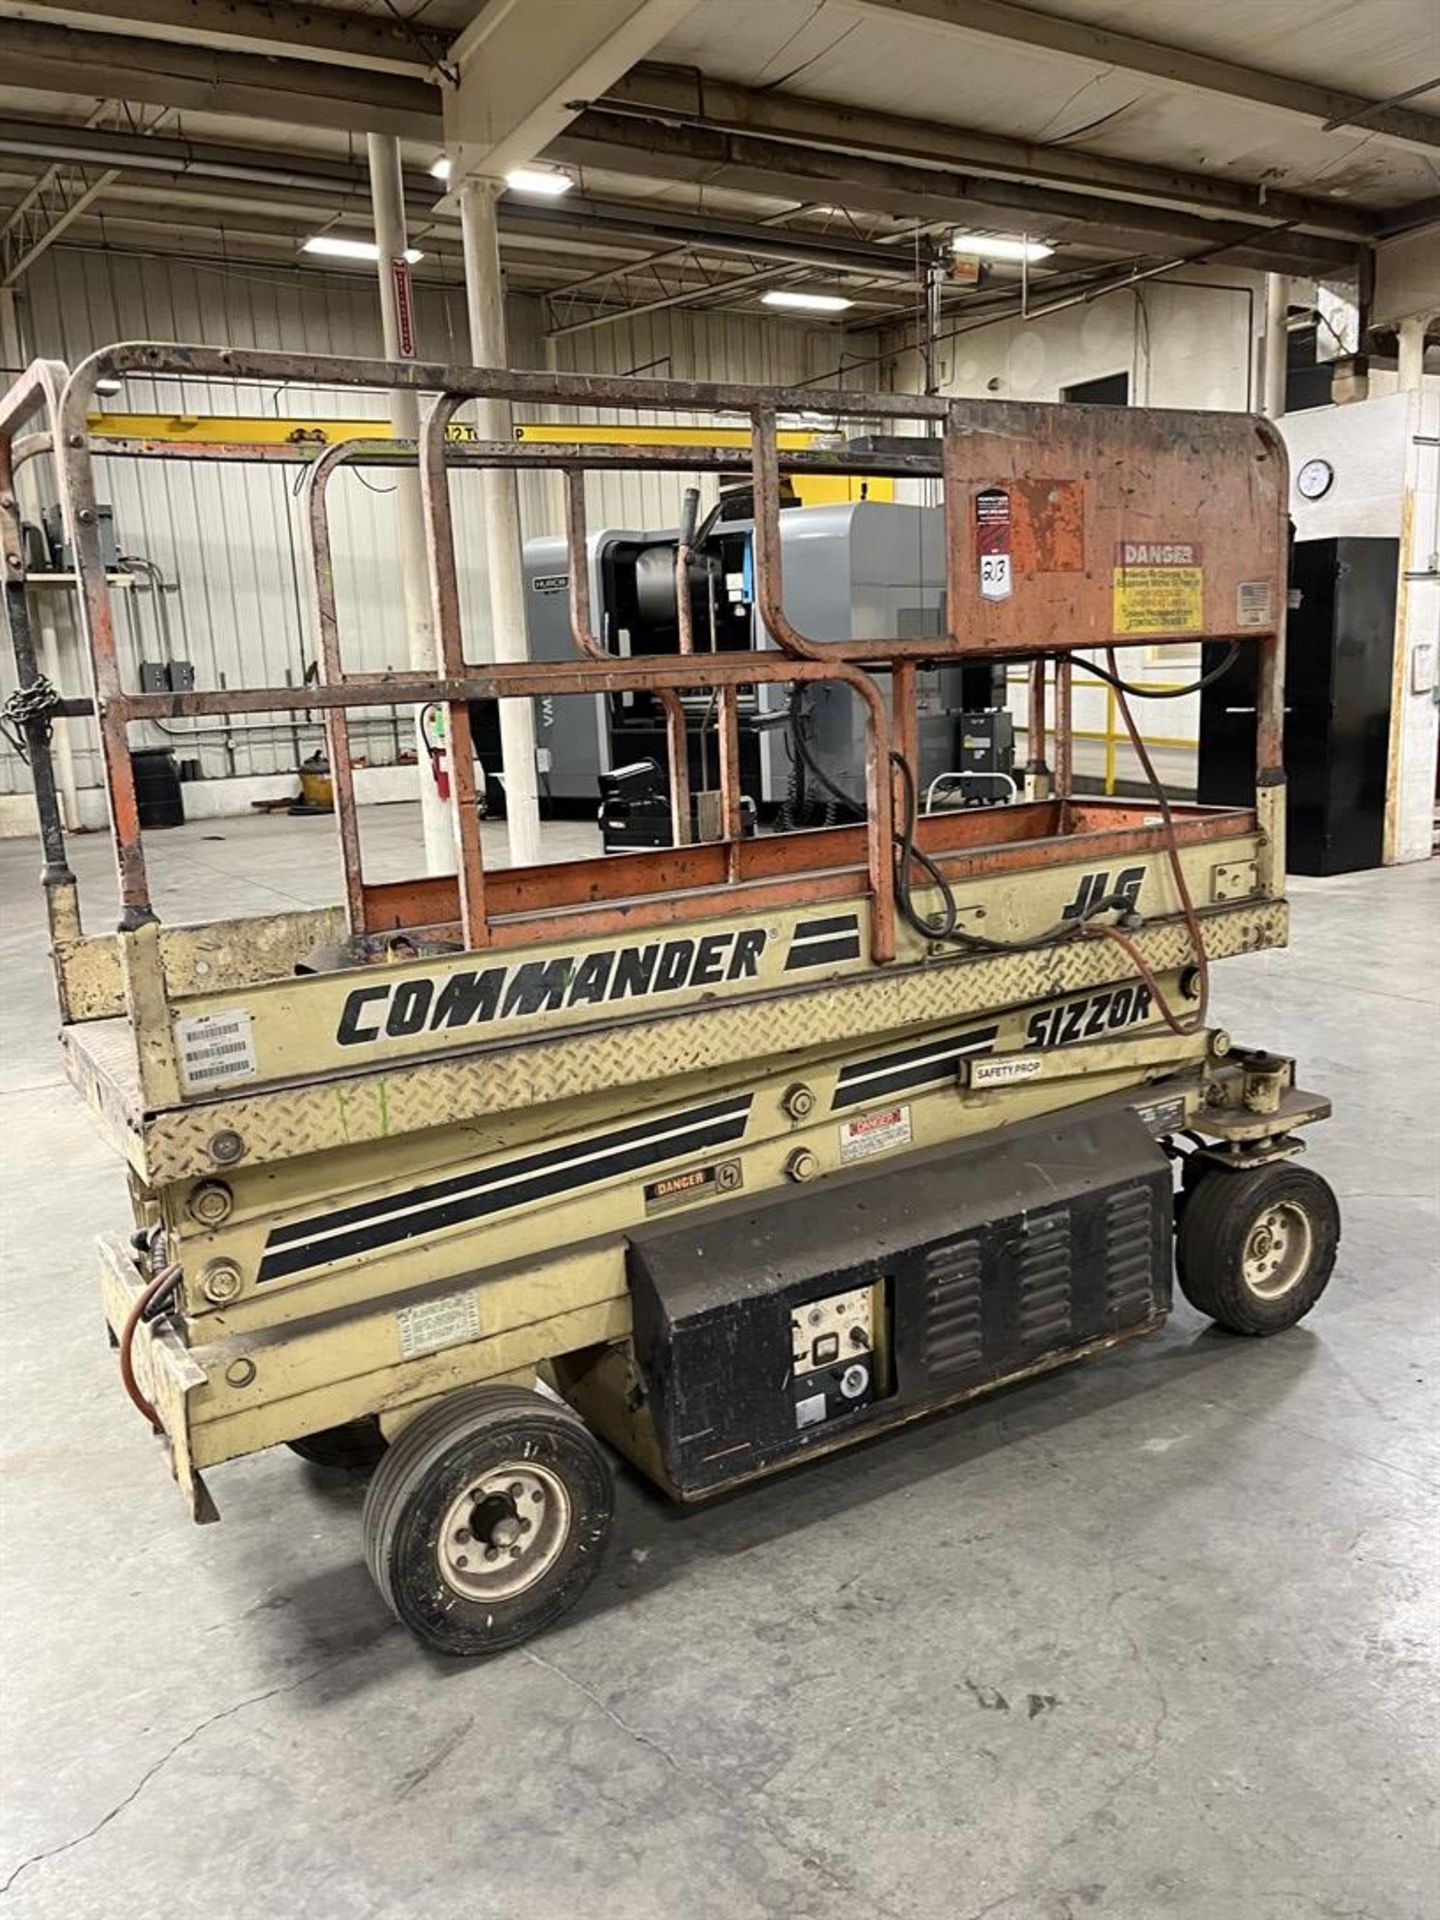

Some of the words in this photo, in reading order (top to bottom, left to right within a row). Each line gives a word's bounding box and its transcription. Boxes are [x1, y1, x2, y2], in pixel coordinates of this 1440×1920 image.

[984, 560, 1006, 582] 213
[1061, 866, 1147, 920] JLG
[1024, 984, 1153, 1049] SIZZOR
[977, 1064, 1014, 1080] SAFETY
[1014, 1061, 1041, 1075] PROP
[655, 1173, 705, 1197] DANGER
